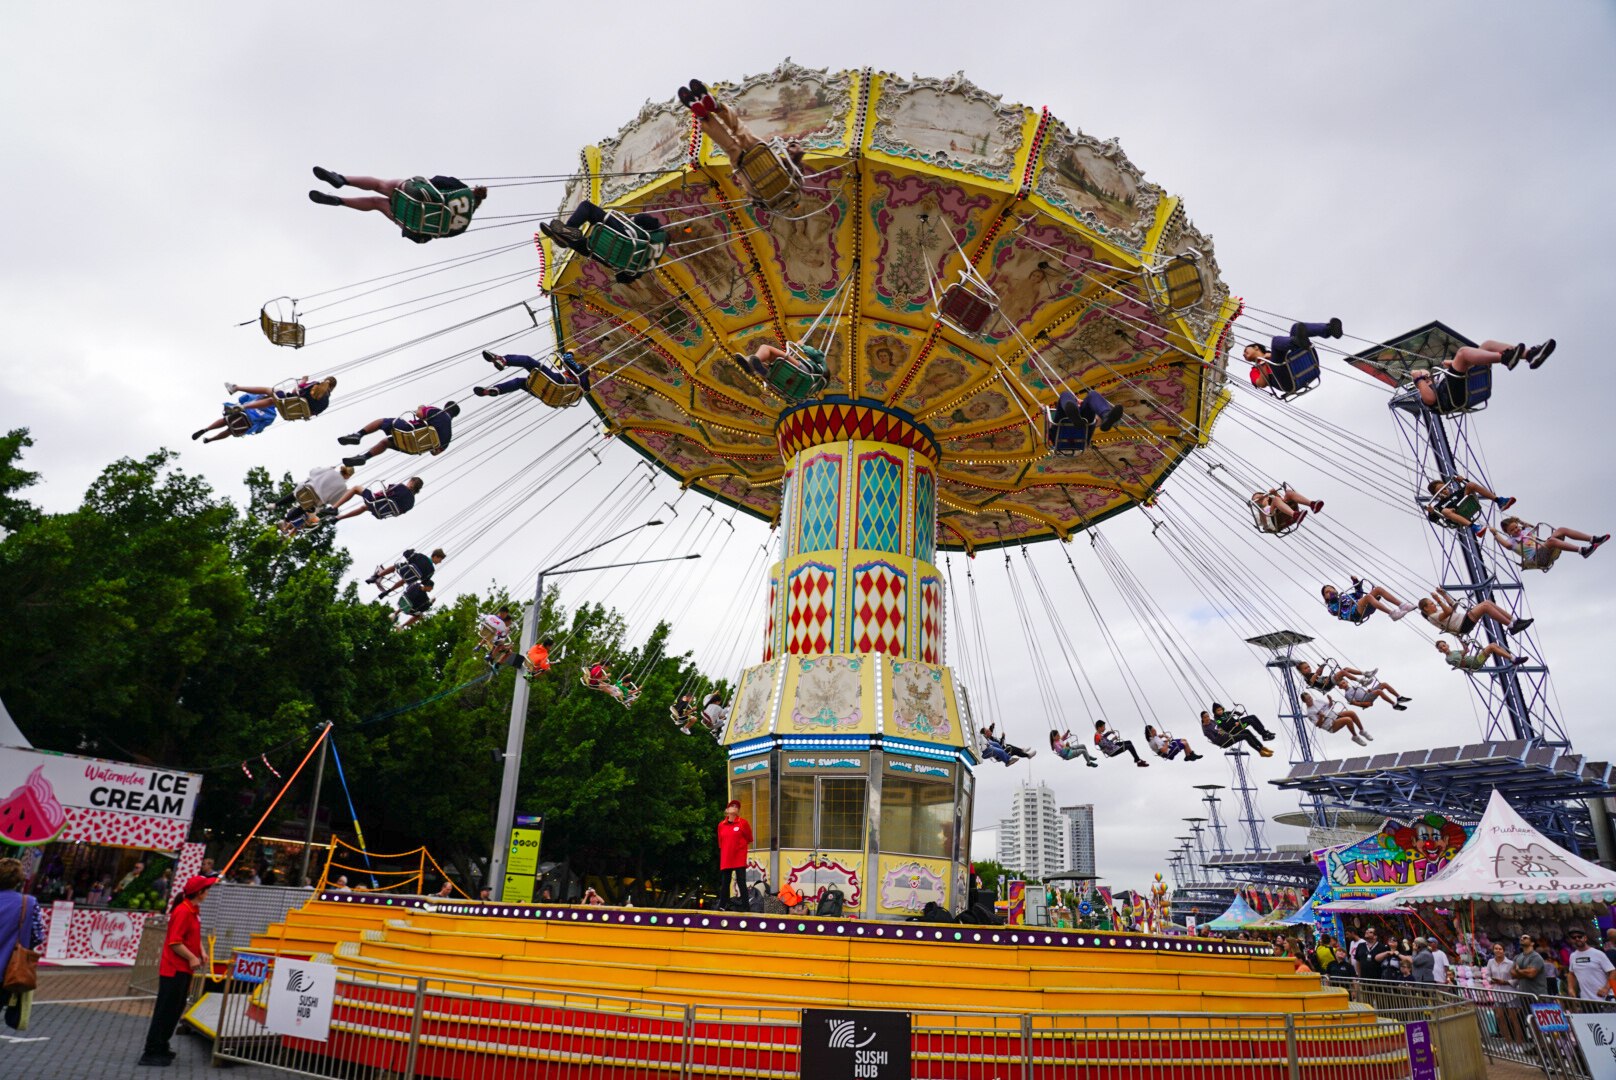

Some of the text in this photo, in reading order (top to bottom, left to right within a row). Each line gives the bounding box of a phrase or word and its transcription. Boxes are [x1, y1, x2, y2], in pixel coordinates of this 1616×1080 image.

[448, 196, 470, 230] 24
[788, 758, 861, 768] WAVE SWINGER
[889, 760, 950, 778] WAVE SWINGER
[84, 764, 190, 795] Watermelon ICE
[89, 786, 184, 816] CREAM
[1345, 859, 1409, 884] FUNNY
[1487, 879, 1616, 891] Pusheen
[91, 914, 125, 934] Melon
[101, 933, 130, 951] Fiesta
[237, 958, 266, 977] EXIT
[299, 995, 319, 1008] SUSHI
[297, 1007, 311, 1019] HUB
[1535, 1009, 1565, 1026] ENTRY
[855, 1050, 889, 1065] SUSHI
[854, 1064, 878, 1078] HUB
